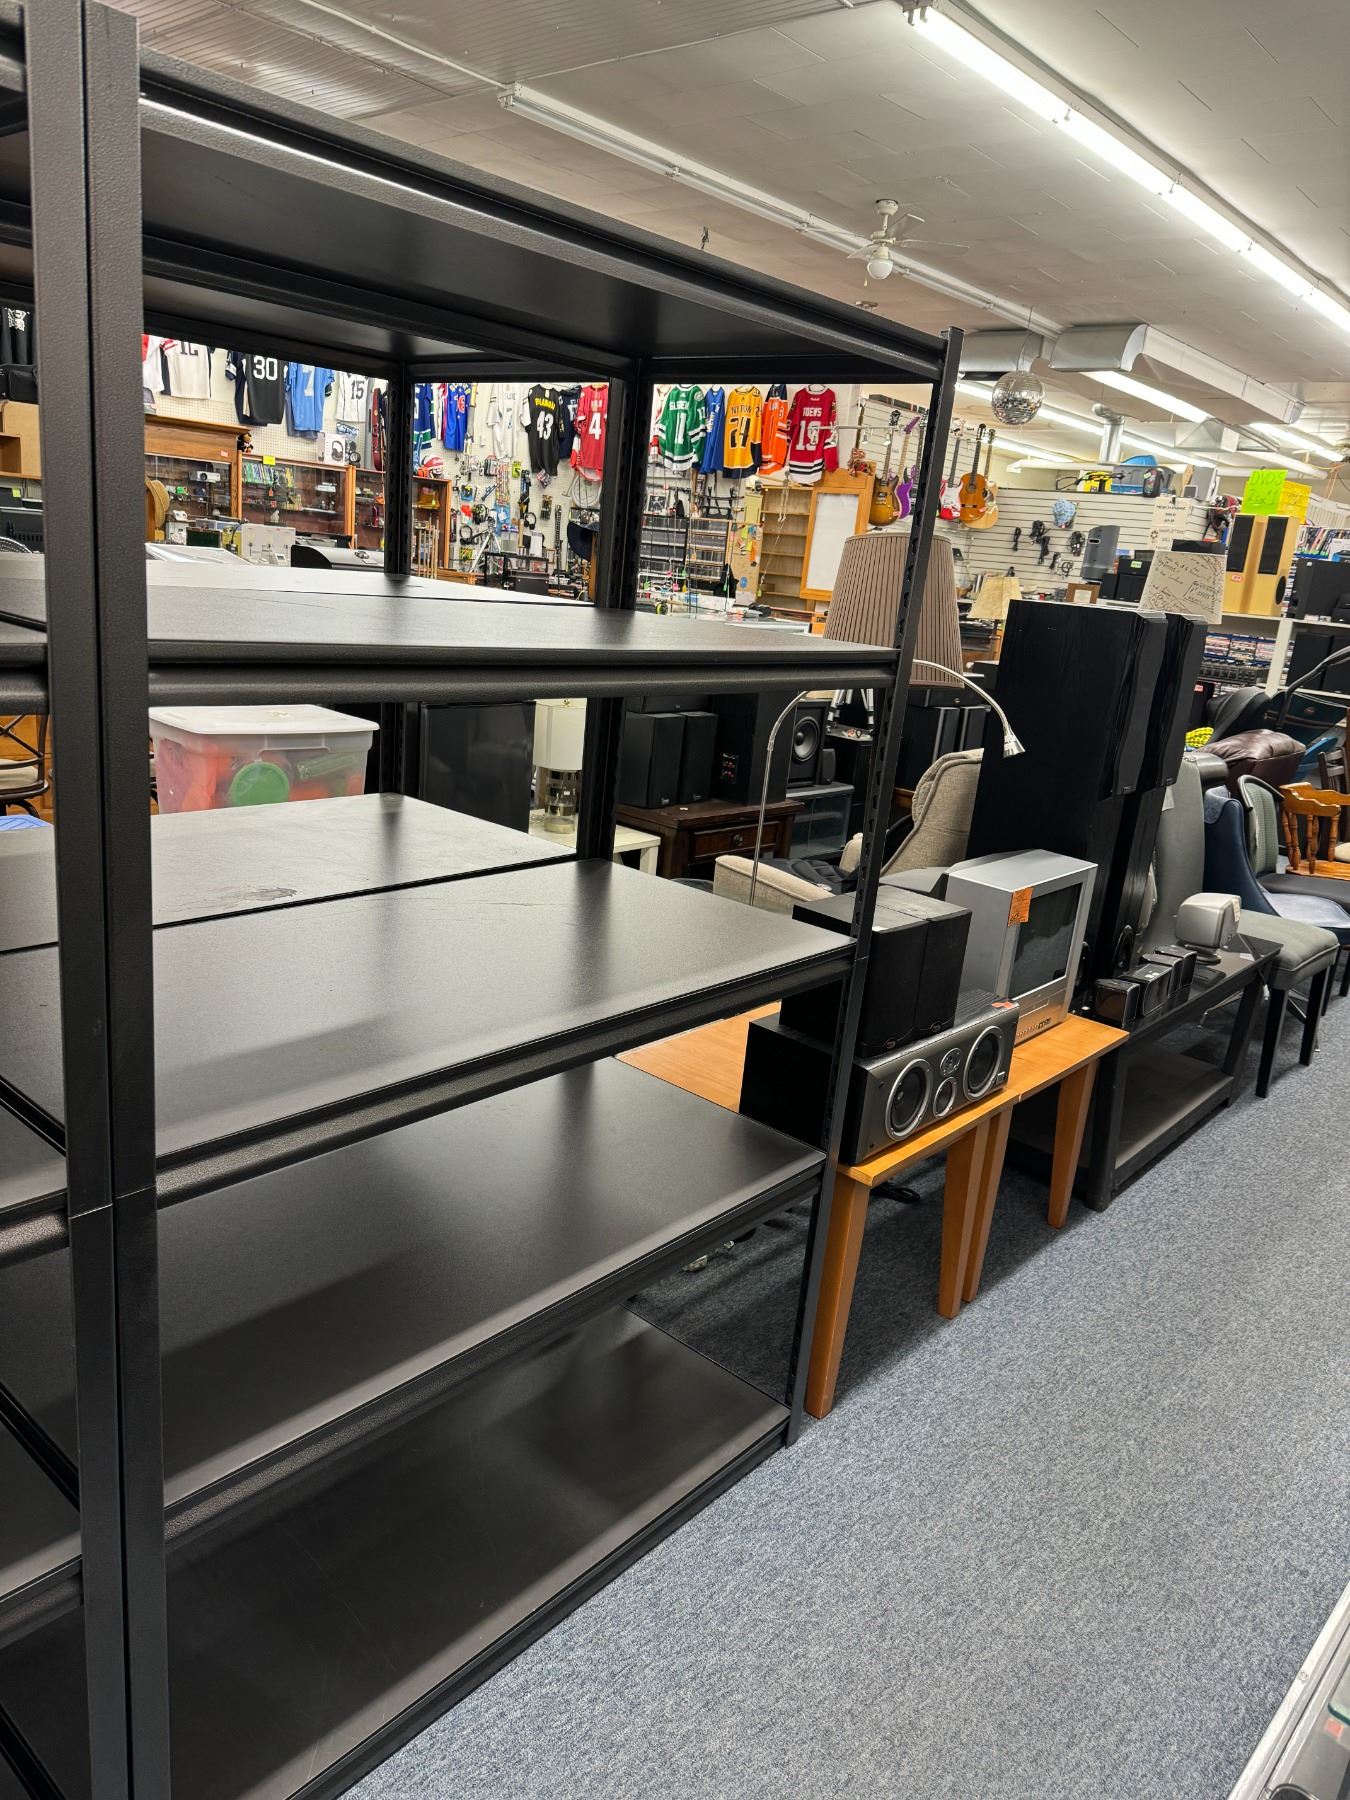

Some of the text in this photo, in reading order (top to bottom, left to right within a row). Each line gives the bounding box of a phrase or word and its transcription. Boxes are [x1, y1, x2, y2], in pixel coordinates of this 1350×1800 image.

[253, 356, 278, 381] 30
[302, 365, 315, 397] 7
[351, 380, 365, 400] 15
[536, 410, 554, 440] 43
[588, 412, 602, 440] 4
[730, 416, 752, 450] 24
[795, 420, 822, 451] 19
